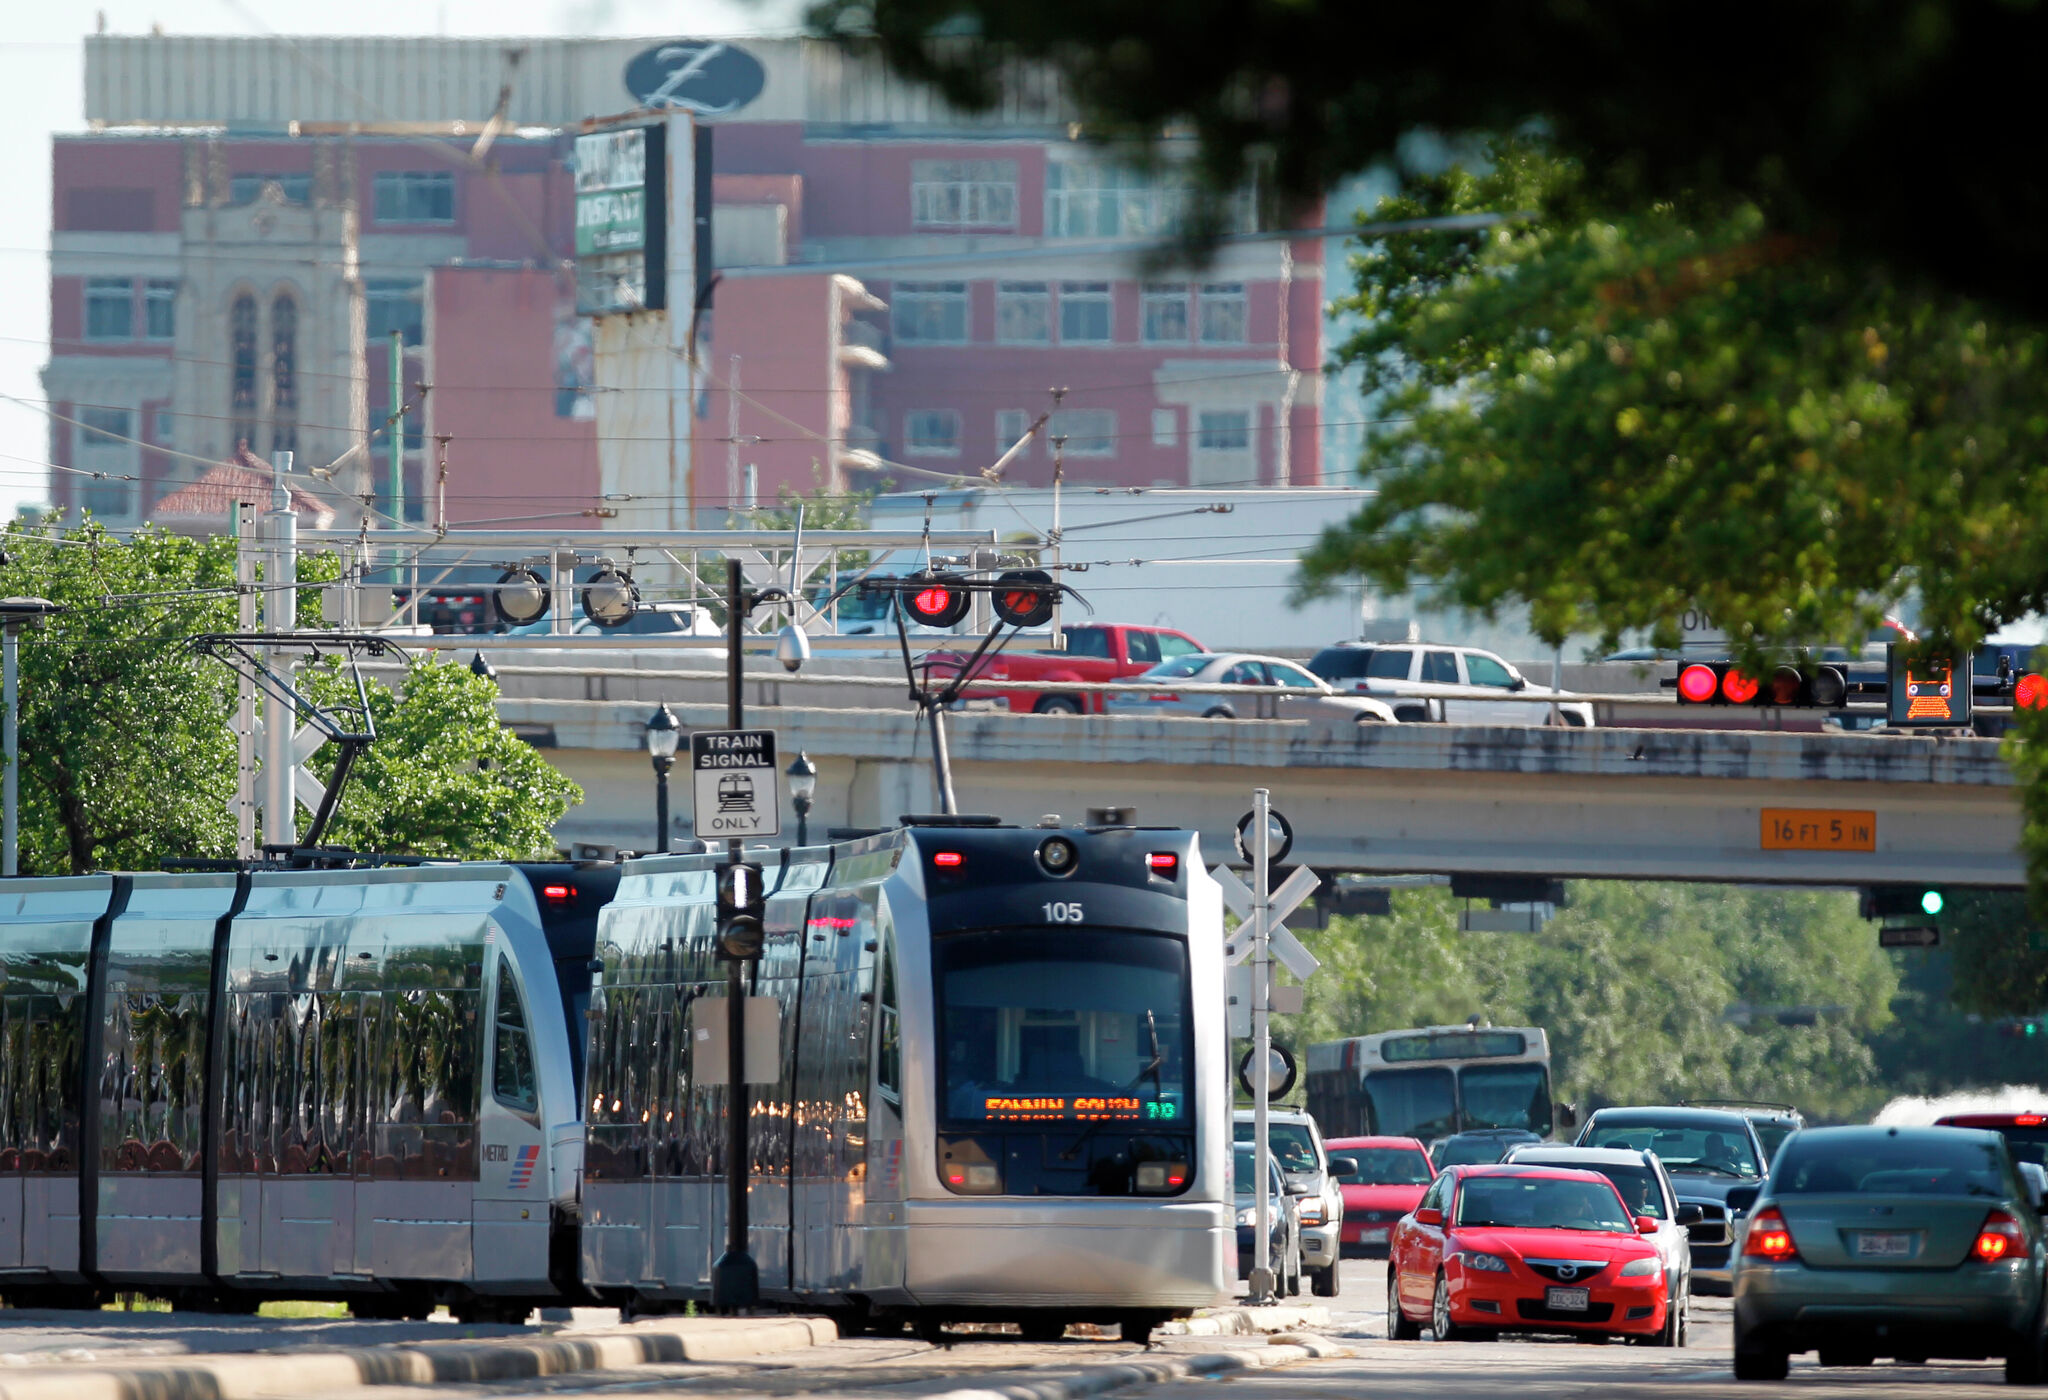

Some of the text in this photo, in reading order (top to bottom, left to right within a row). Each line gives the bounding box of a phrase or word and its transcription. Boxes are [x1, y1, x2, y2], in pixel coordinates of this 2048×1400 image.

[706, 735, 763, 749] TRAIN
[700, 753, 769, 767] SIGNAL
[712, 817, 761, 829] ONLY
[1774, 820, 1869, 842] 16 FT 5 IN
[1042, 902, 1083, 921] 105
[482, 1144, 508, 1161] METRO
